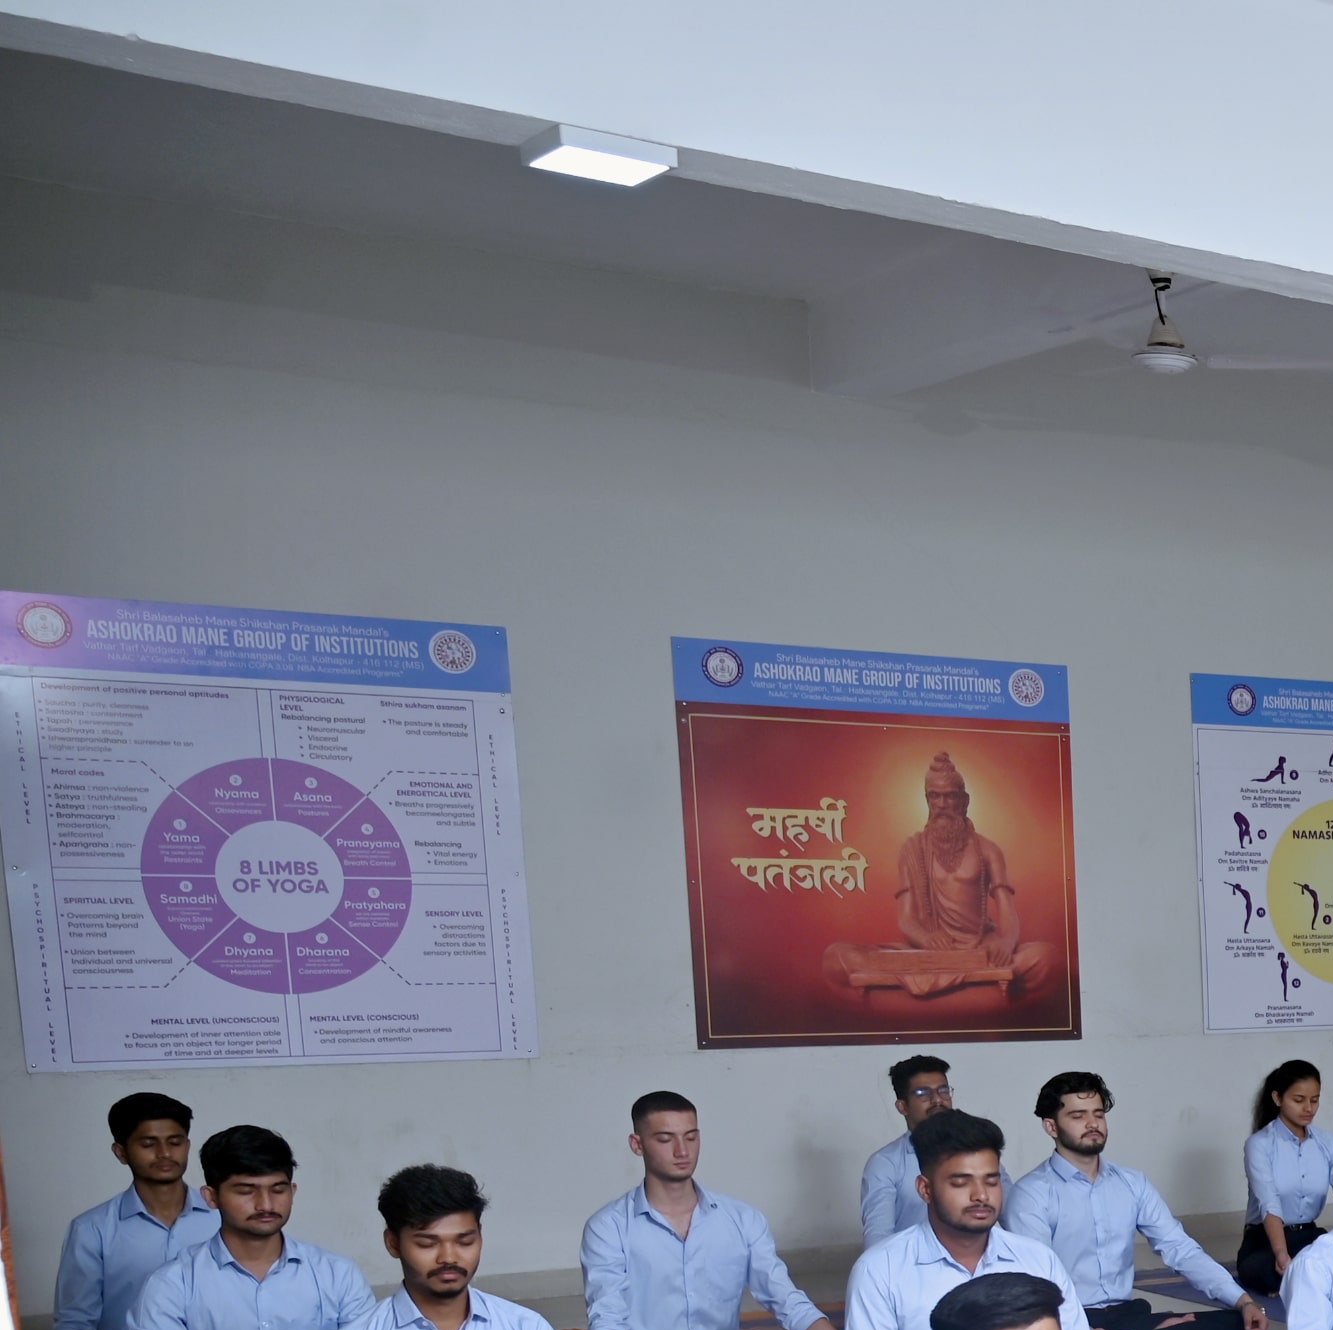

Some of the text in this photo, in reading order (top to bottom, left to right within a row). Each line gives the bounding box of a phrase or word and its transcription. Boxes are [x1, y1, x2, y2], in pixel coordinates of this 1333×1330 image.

[87, 619, 419, 659] ASHOKRAO MANE GROUP OF INSTITUTIONS
[754, 662, 1001, 694] ASHOKRAO MANE GROUP OF INSTITUTIONS
[1262, 696, 1309, 710] ASHOKRAO
[214, 788, 260, 800] Nyama
[293, 791, 332, 802] Asana
[163, 832, 200, 843] Yama
[336, 838, 400, 850] Pranayama
[239, 860, 319, 876] 8 LIMBS
[232, 878, 330, 894] OF YOGA
[160, 894, 218, 904] Samadhi
[344, 900, 406, 912] Pratyahara
[224, 946, 274, 958] Dhyana
[296, 946, 350, 957] Dharana
